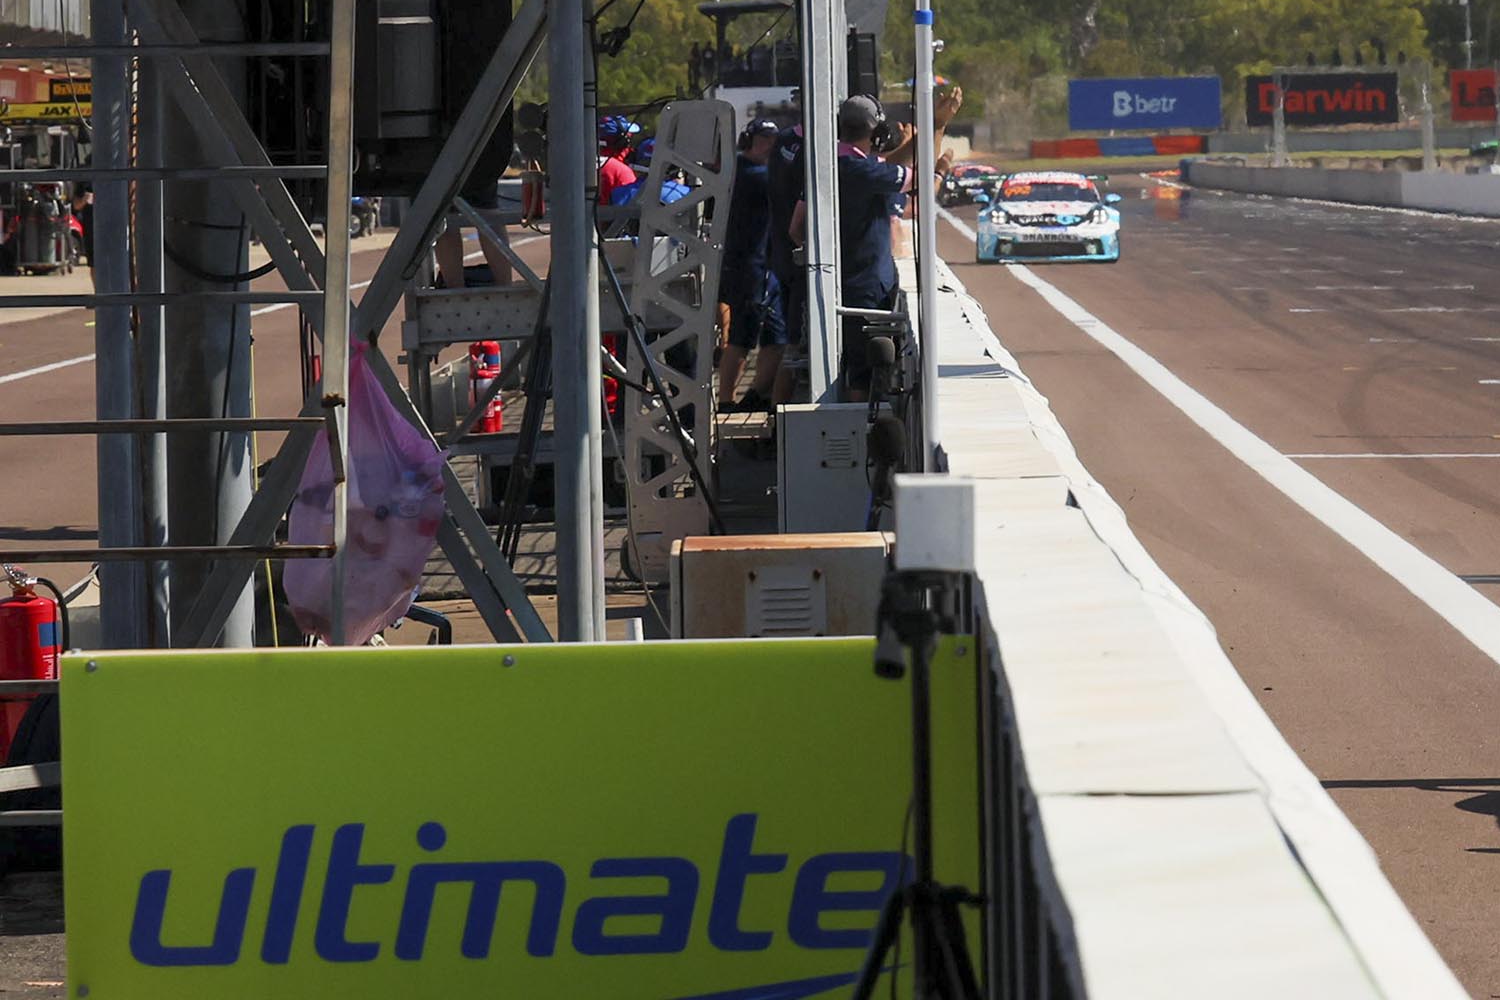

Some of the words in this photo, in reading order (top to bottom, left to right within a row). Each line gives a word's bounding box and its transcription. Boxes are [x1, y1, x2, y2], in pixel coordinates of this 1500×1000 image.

[1134, 94, 1177, 113] betr
[1258, 82, 1387, 113] Darwin
[129, 813, 915, 967] ultimate
